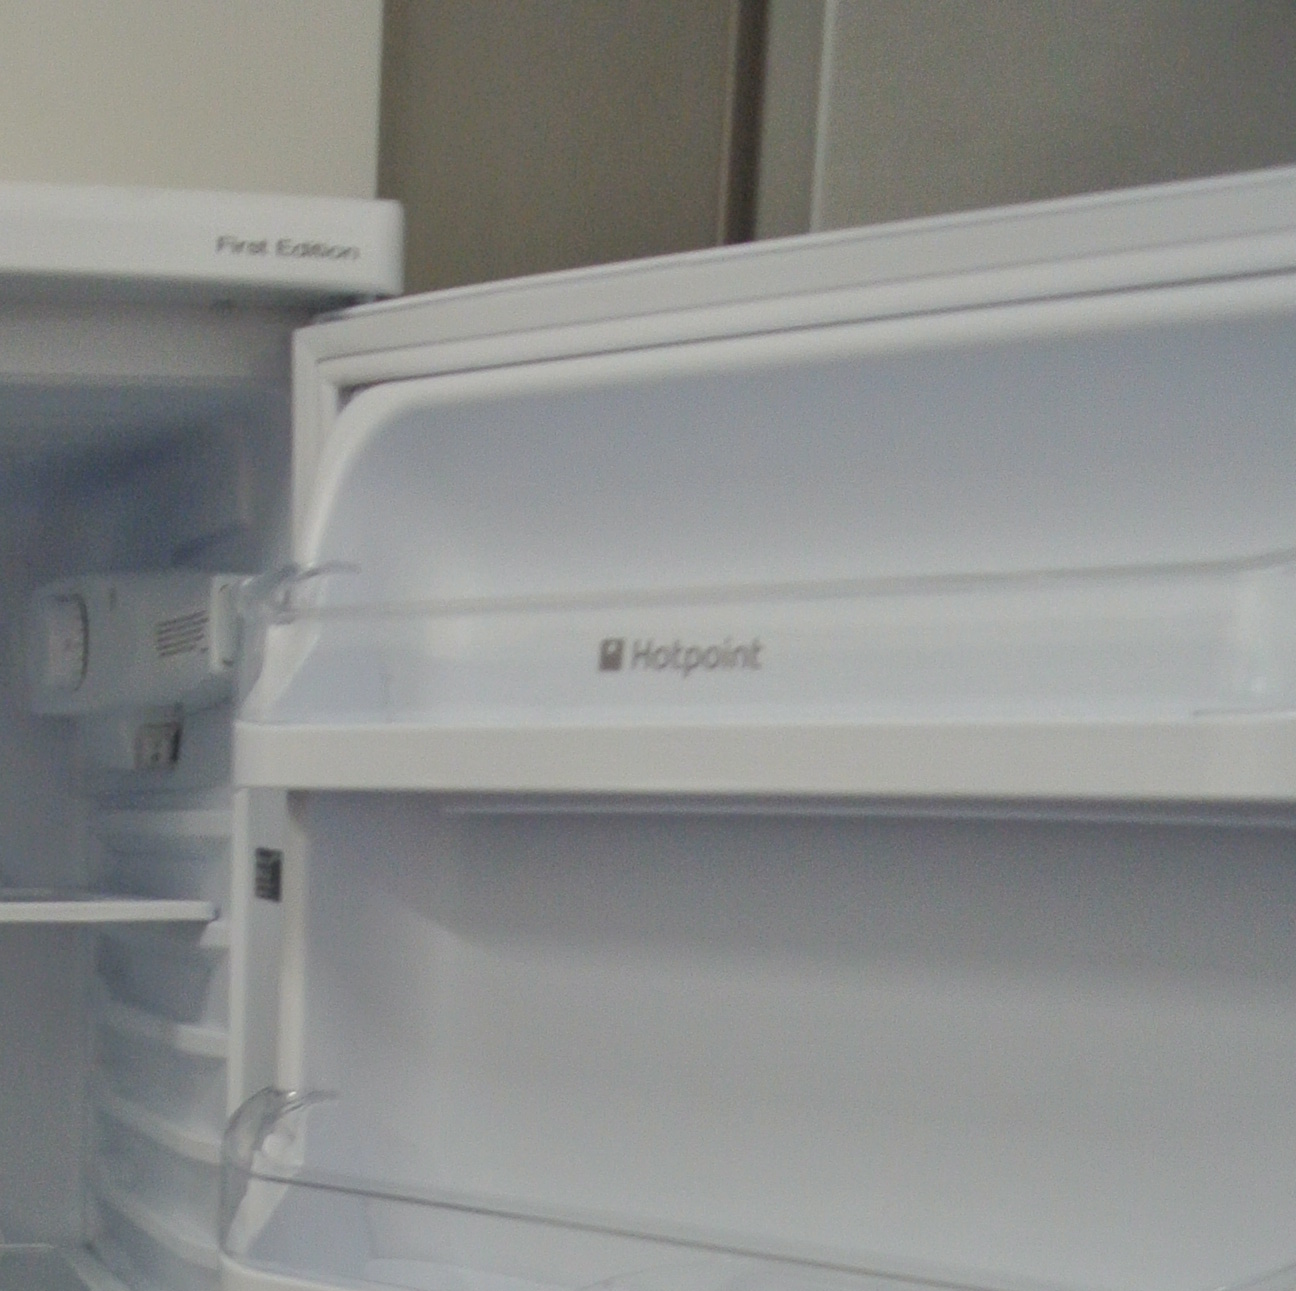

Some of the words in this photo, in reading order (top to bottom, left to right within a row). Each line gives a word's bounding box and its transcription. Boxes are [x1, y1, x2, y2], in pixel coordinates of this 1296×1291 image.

[216, 234, 267, 254] First
[275, 238, 361, 260] Edition
[631, 635, 764, 678] Hotpoint
